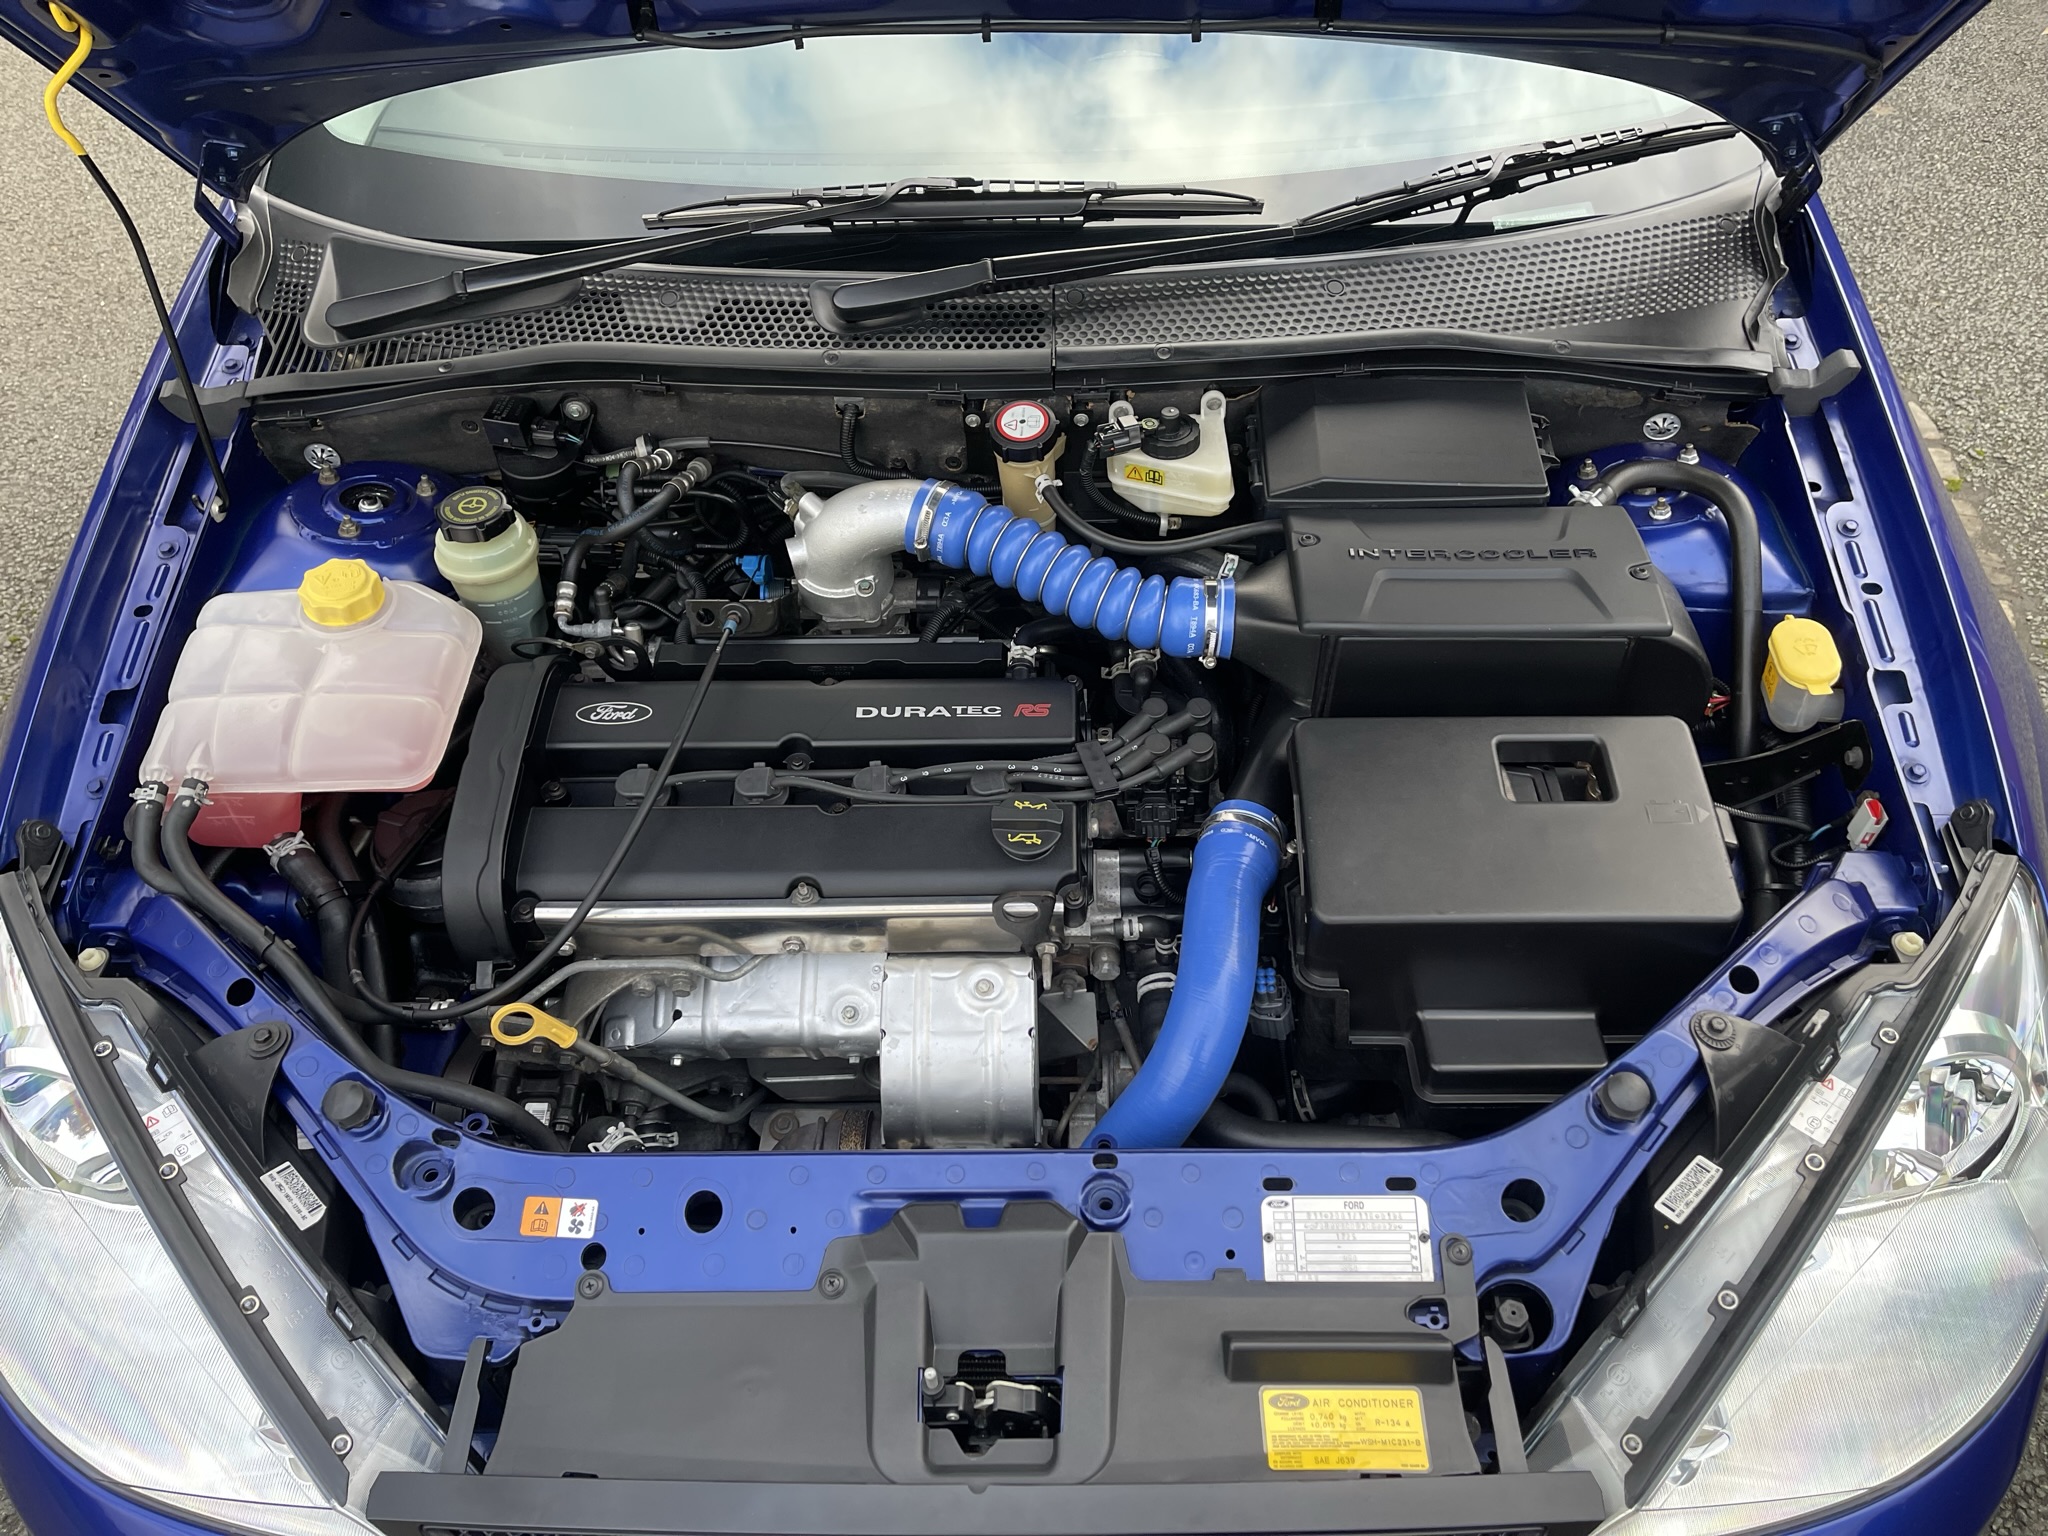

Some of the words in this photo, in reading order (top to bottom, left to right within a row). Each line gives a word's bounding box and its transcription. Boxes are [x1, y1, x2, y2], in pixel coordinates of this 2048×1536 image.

[1348, 548, 1597, 560] INTERCOOLER
[855, 706, 1002, 718] DURATEC
[1013, 704, 1051, 717] RS
[1344, 1201, 1364, 1210] FORD
[1312, 1398, 1330, 1407] AIR
[1338, 1398, 1414, 1408] CONDITIONER
[1339, 1414, 1347, 1422] kg
[1375, 1419, 1401, 1427] R-134
[1314, 1456, 1330, 1464] SAE
[1335, 1457, 1355, 1465] J639
